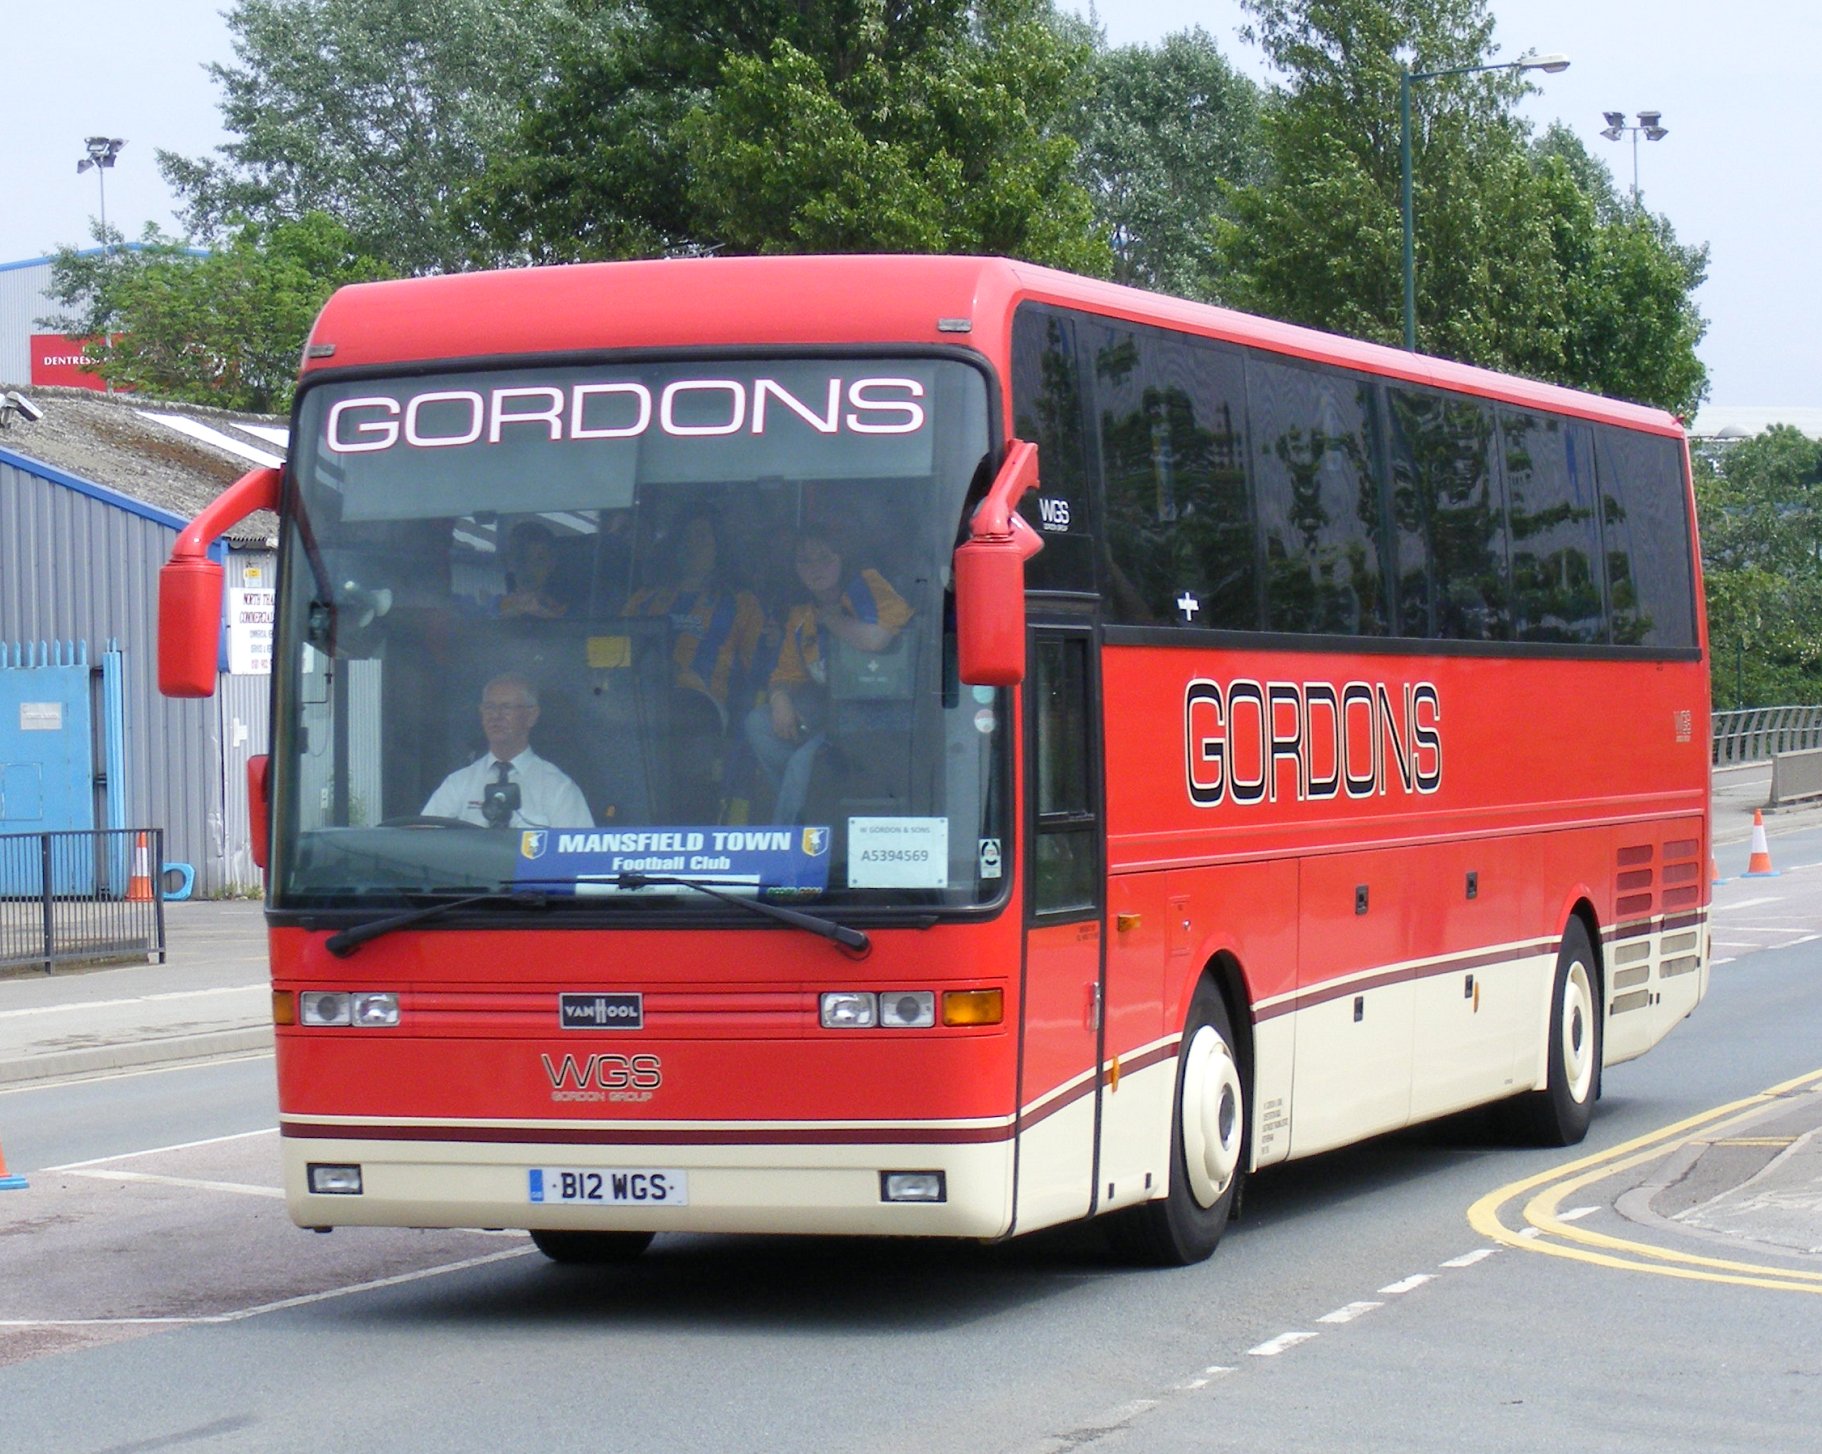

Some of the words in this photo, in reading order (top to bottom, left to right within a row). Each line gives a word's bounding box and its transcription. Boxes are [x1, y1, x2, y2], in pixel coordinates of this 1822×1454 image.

[326, 378, 925, 454] GORDONS
[1039, 497, 1070, 524] WGS
[1184, 677, 1443, 808] GORDONS
[557, 832, 704, 854] MANSFIELD
[711, 831, 792, 851] TOWN
[869, 826, 901, 834] GORDON
[903, 826, 909, 834] &
[910, 826, 931, 834] SONS
[611, 855, 685, 871] Football
[689, 855, 732, 871] Club
[860, 849, 930, 862] A5394569
[540, 1053, 662, 1090] WGS
[551, 1091, 605, 1102] GORDON
[608, 1091, 653, 1102] GROUP
[560, 1172, 603, 1200] B12
[611, 1173, 667, 1200] WGS
